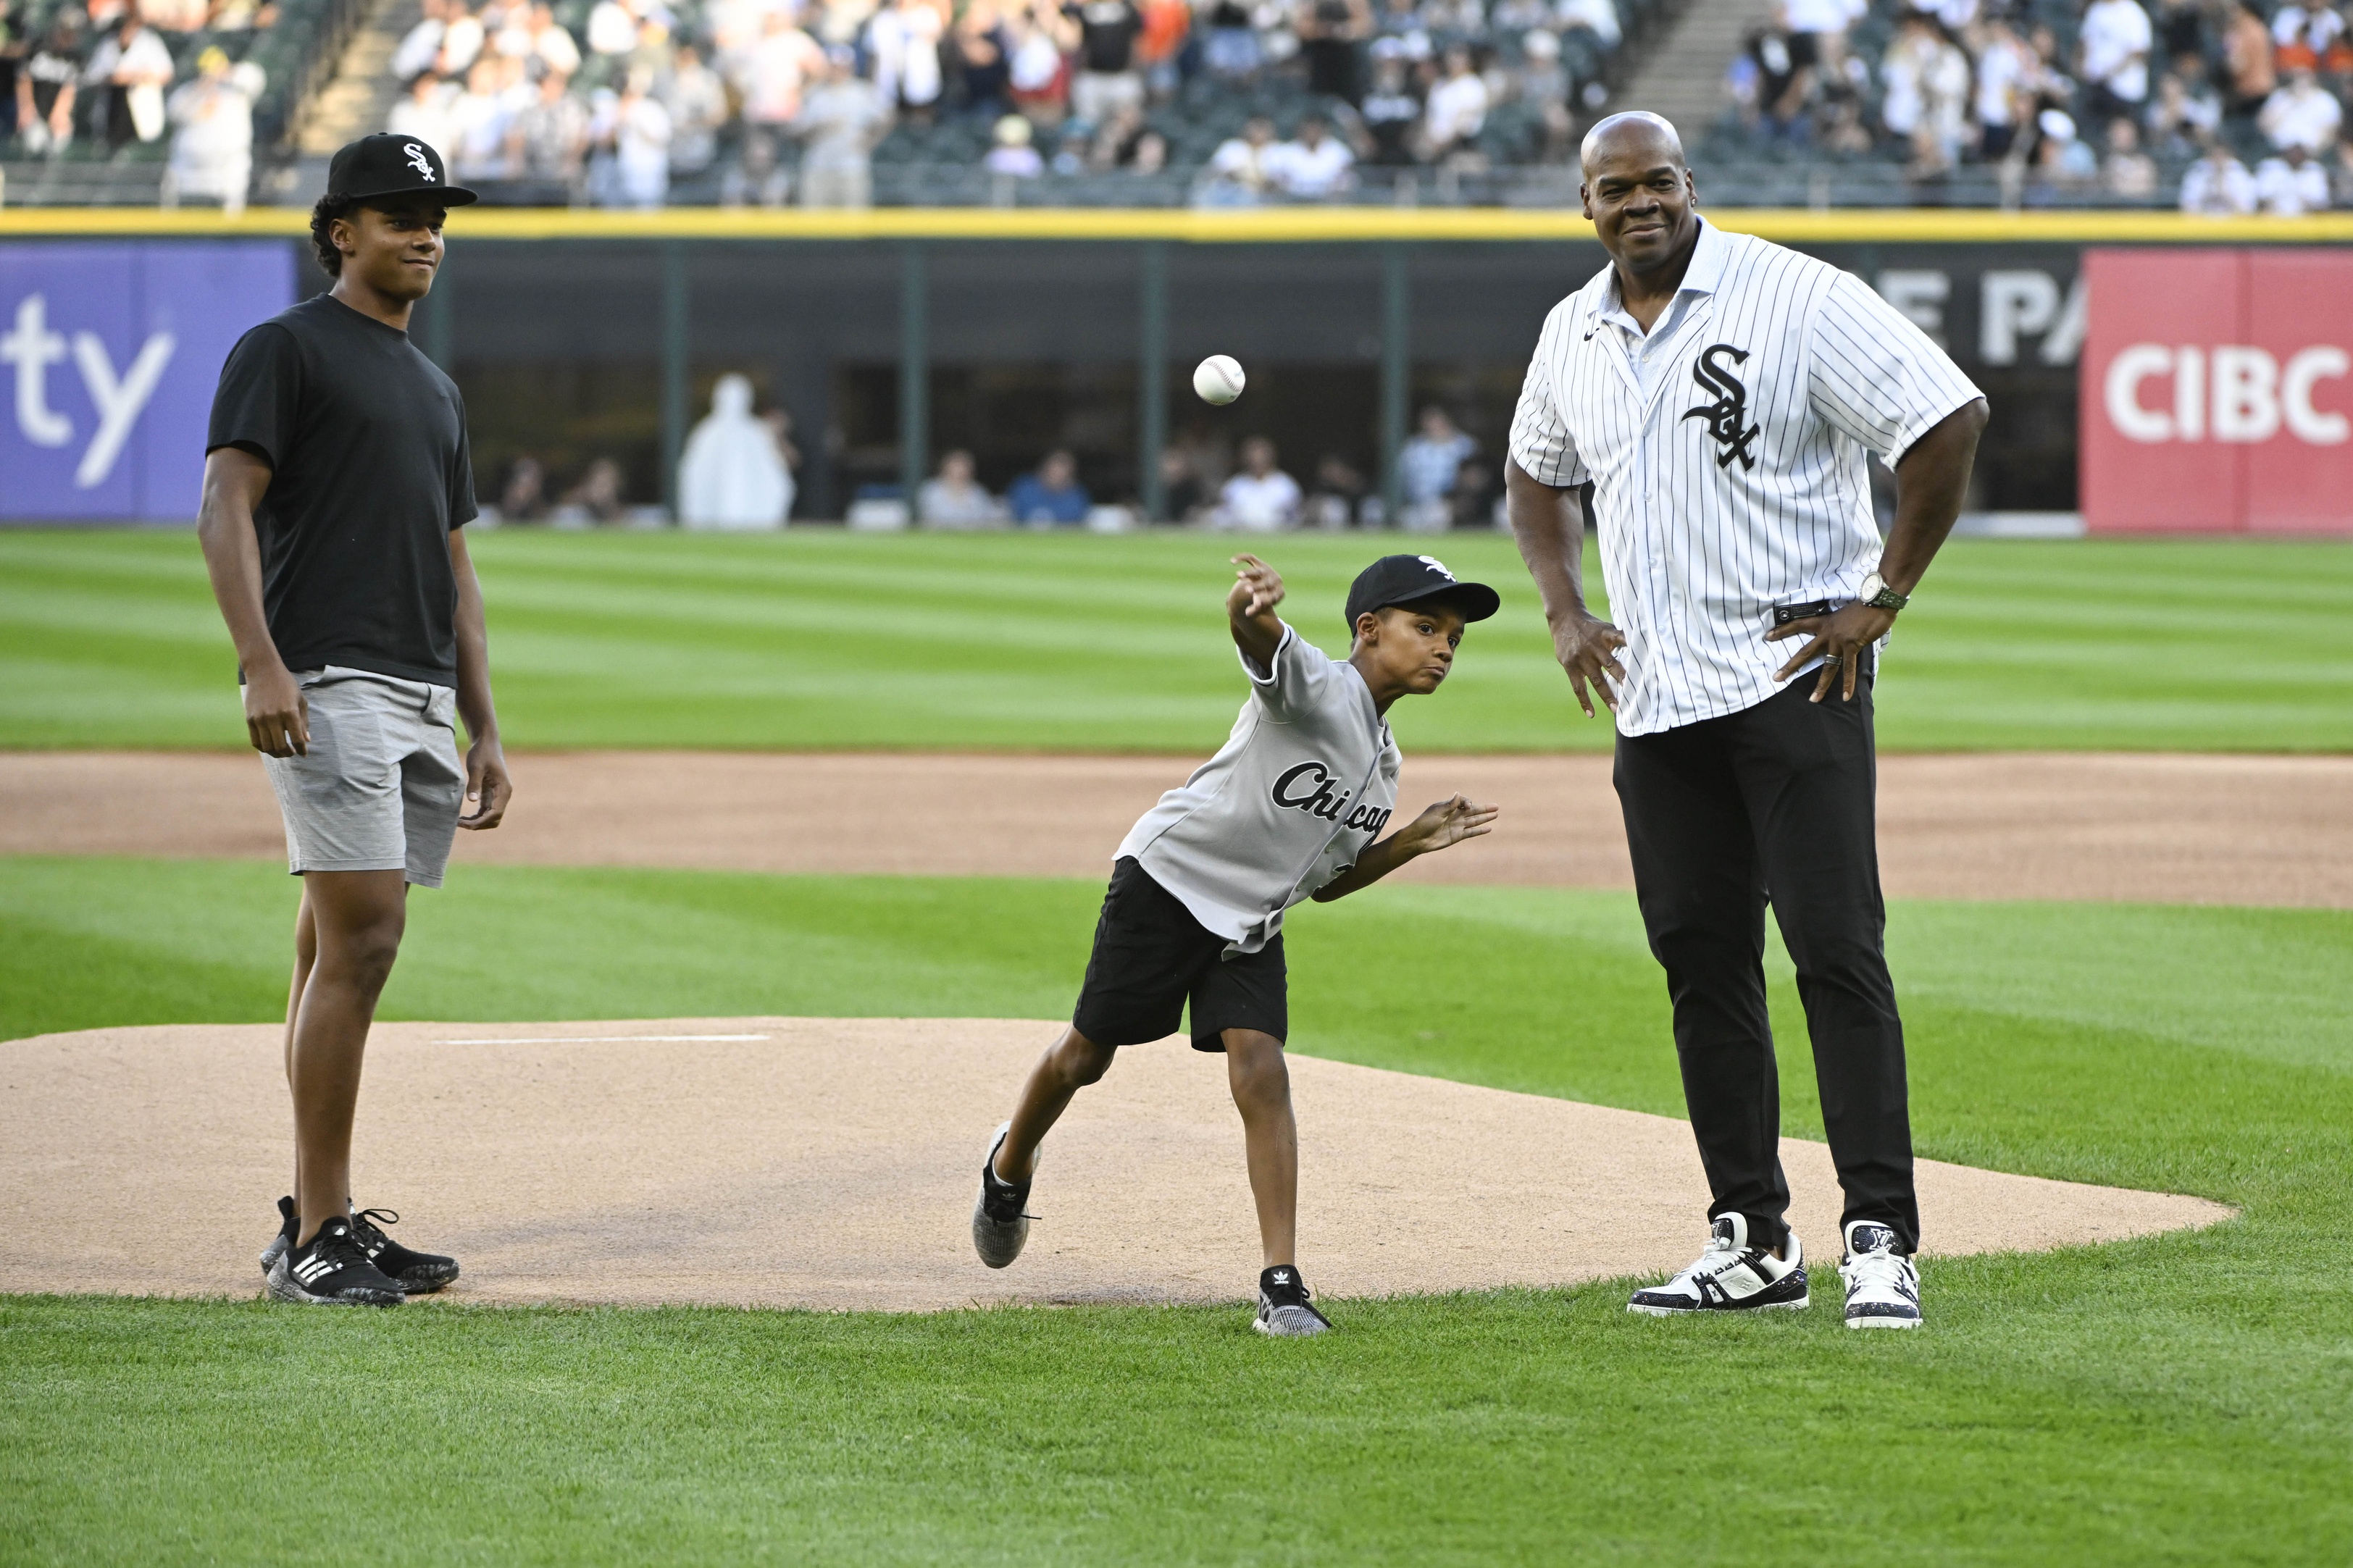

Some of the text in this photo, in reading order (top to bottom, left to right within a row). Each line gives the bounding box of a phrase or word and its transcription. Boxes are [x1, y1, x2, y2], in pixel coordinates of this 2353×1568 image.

[404, 143, 436, 182] Sox
[0, 292, 177, 488] ty
[1678, 343, 1761, 473] Sox
[2106, 344, 2350, 444] CIBC
